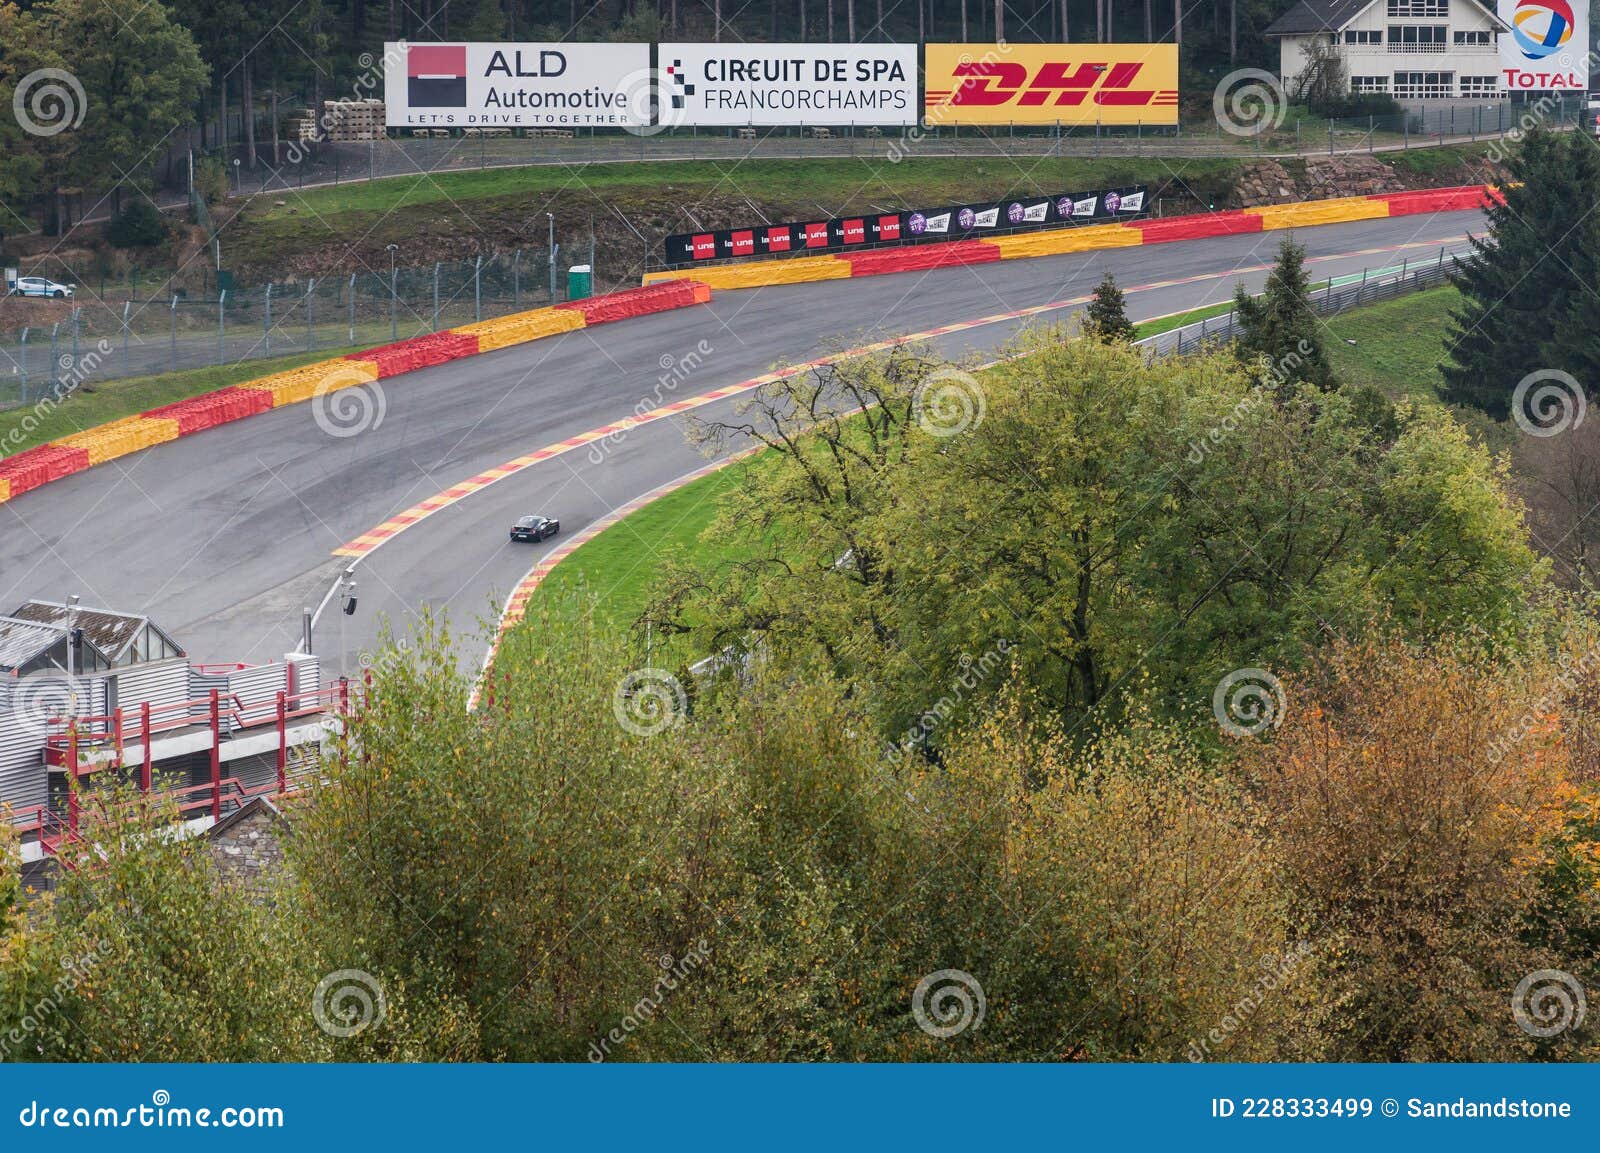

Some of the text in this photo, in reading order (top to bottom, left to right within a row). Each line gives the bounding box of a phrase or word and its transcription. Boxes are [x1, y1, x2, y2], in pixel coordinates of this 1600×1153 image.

[484, 50, 567, 78] ALD
[704, 59, 906, 82] CIRCUIT DE SPA
[949, 61, 1155, 106] DHL
[484, 86, 628, 108] Automotive
[705, 88, 907, 109] FRANCORCHAMPS
[407, 114, 628, 124] LET'S DRIVE TOGETHER
